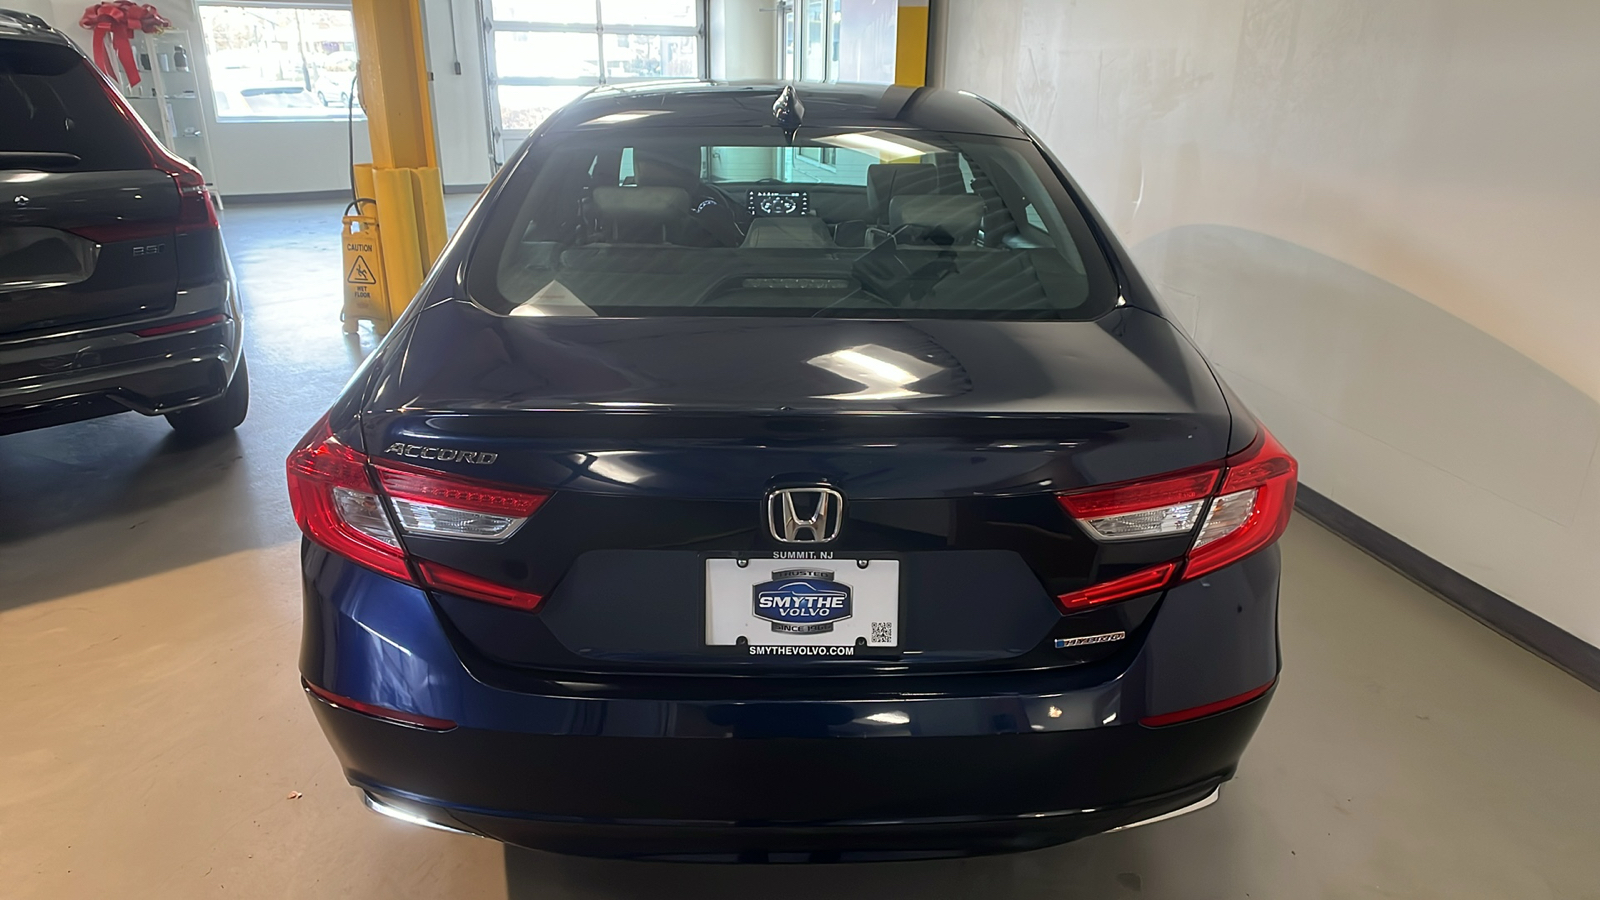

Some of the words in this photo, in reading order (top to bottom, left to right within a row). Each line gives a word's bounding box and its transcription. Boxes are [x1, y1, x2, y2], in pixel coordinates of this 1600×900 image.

[347, 244, 372, 252] CAUTION
[384, 442, 498, 464] ACCORD
[773, 551, 817, 560] SUMMIT,
[820, 551, 834, 559] NJ
[780, 570, 829, 578] TRUSTED
[759, 596, 845, 608] SMYTHE
[779, 608, 830, 617] VOLVO
[749, 646, 854, 656] SMYTHEVOLVO.COM
